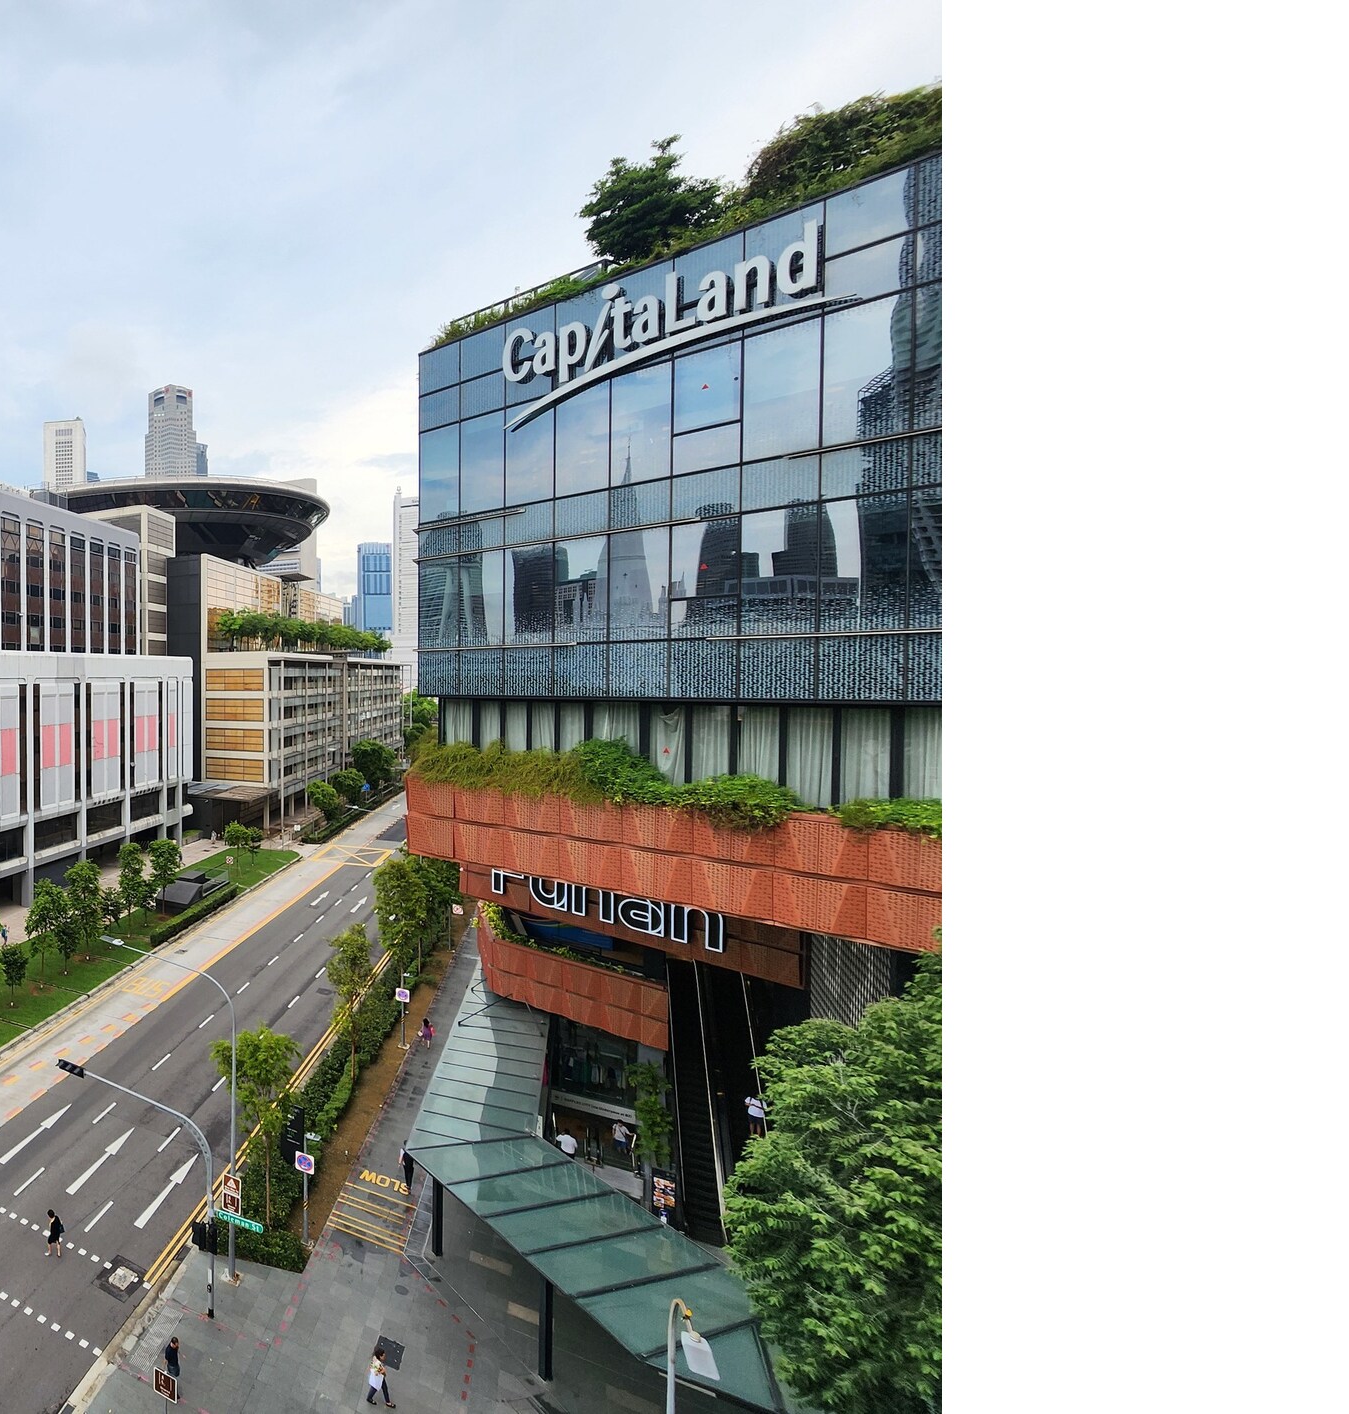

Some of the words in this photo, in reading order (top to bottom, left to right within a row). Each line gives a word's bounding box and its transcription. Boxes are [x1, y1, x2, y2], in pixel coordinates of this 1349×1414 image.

[503, 219, 820, 383] CapitaLand
[122, 976, 171, 998] BUS
[359, 1169, 410, 1195] SLOW
[218, 1212, 251, 1229] Coleman
[251, 1223, 260, 1233] St
